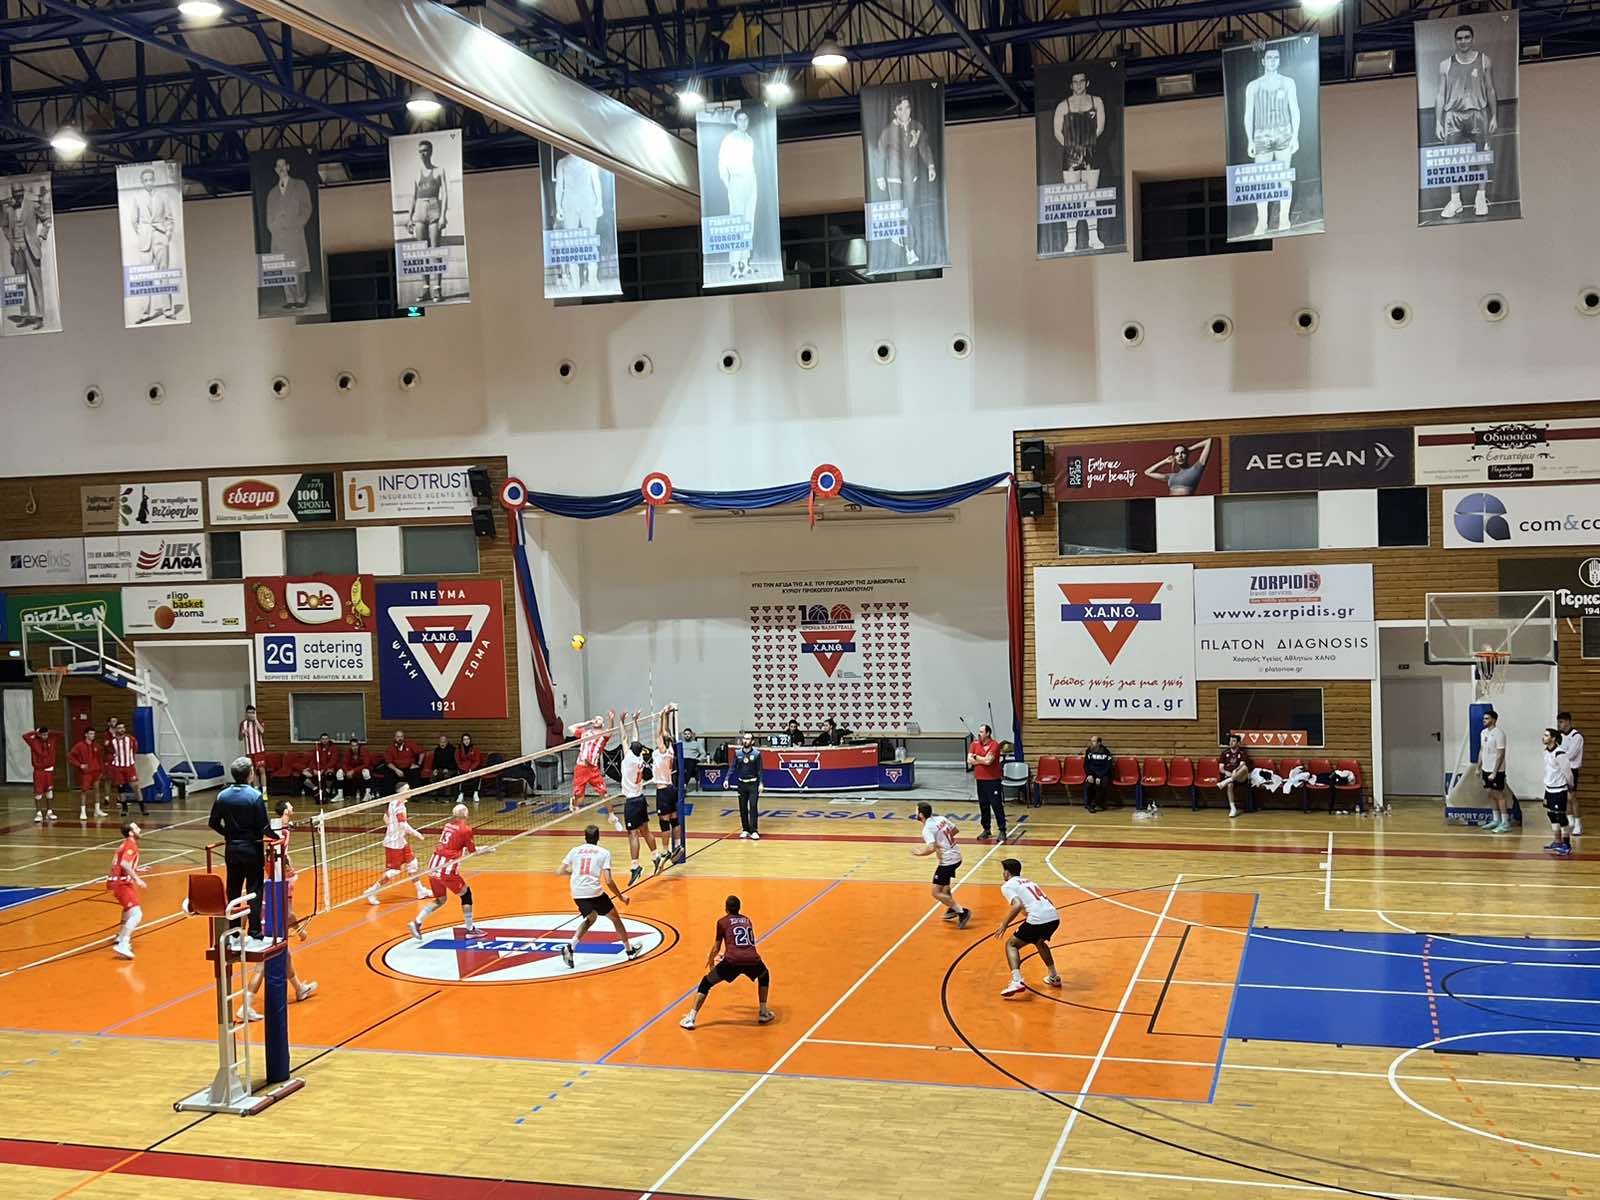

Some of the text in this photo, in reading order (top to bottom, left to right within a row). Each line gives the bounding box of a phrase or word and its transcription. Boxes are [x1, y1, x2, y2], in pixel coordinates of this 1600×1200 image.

[1426, 165, 1466, 176] SOTIRIS
[1427, 173, 1485, 185] NIKOLAIDIS
[1235, 182, 1276, 193] DIONISIS
[1235, 190, 1289, 202] ANANIADIS
[1044, 202, 1081, 212] MIHALIS
[1044, 208, 1113, 221] GIANNOUZAKOS
[403, 258, 424, 266] TAKIS
[403, 265, 447, 274] TALIADOROS
[1483, 432, 1538, 443] Οδυσσέας
[1088, 457, 1121, 473] Embrace
[1246, 450, 1366, 471] AEGEAN
[378, 471, 470, 491] INFOTRUST
[1087, 469, 1138, 489] your beauty
[297, 490, 318, 500] 100
[297, 500, 331, 510] ΧΡΟΝΙΑ
[160, 556, 203, 570] ΑΛΦΑ
[1250, 574, 1319, 591] ZORPIDIS
[296, 590, 334, 609] Dole
[411, 590, 466, 600] ΠΝΕΥΜΑ
[172, 599, 204, 609] basket
[174, 609, 205, 618] akoma
[1084, 606, 1139, 618] Χ.Α.Ν.Θ.
[1213, 605, 1355, 620] www.zorpidis.gr
[266, 643, 294, 665] 2G
[303, 640, 363, 656] catering
[304, 656, 364, 669] services
[392, 640, 418, 679] ΨΥΧΗ
[465, 639, 491, 679] ΣΩΜΑ
[431, 701, 456, 711] 1921
[1049, 698, 1184, 711] www.ymca.gr
[733, 926, 755, 946] 20
